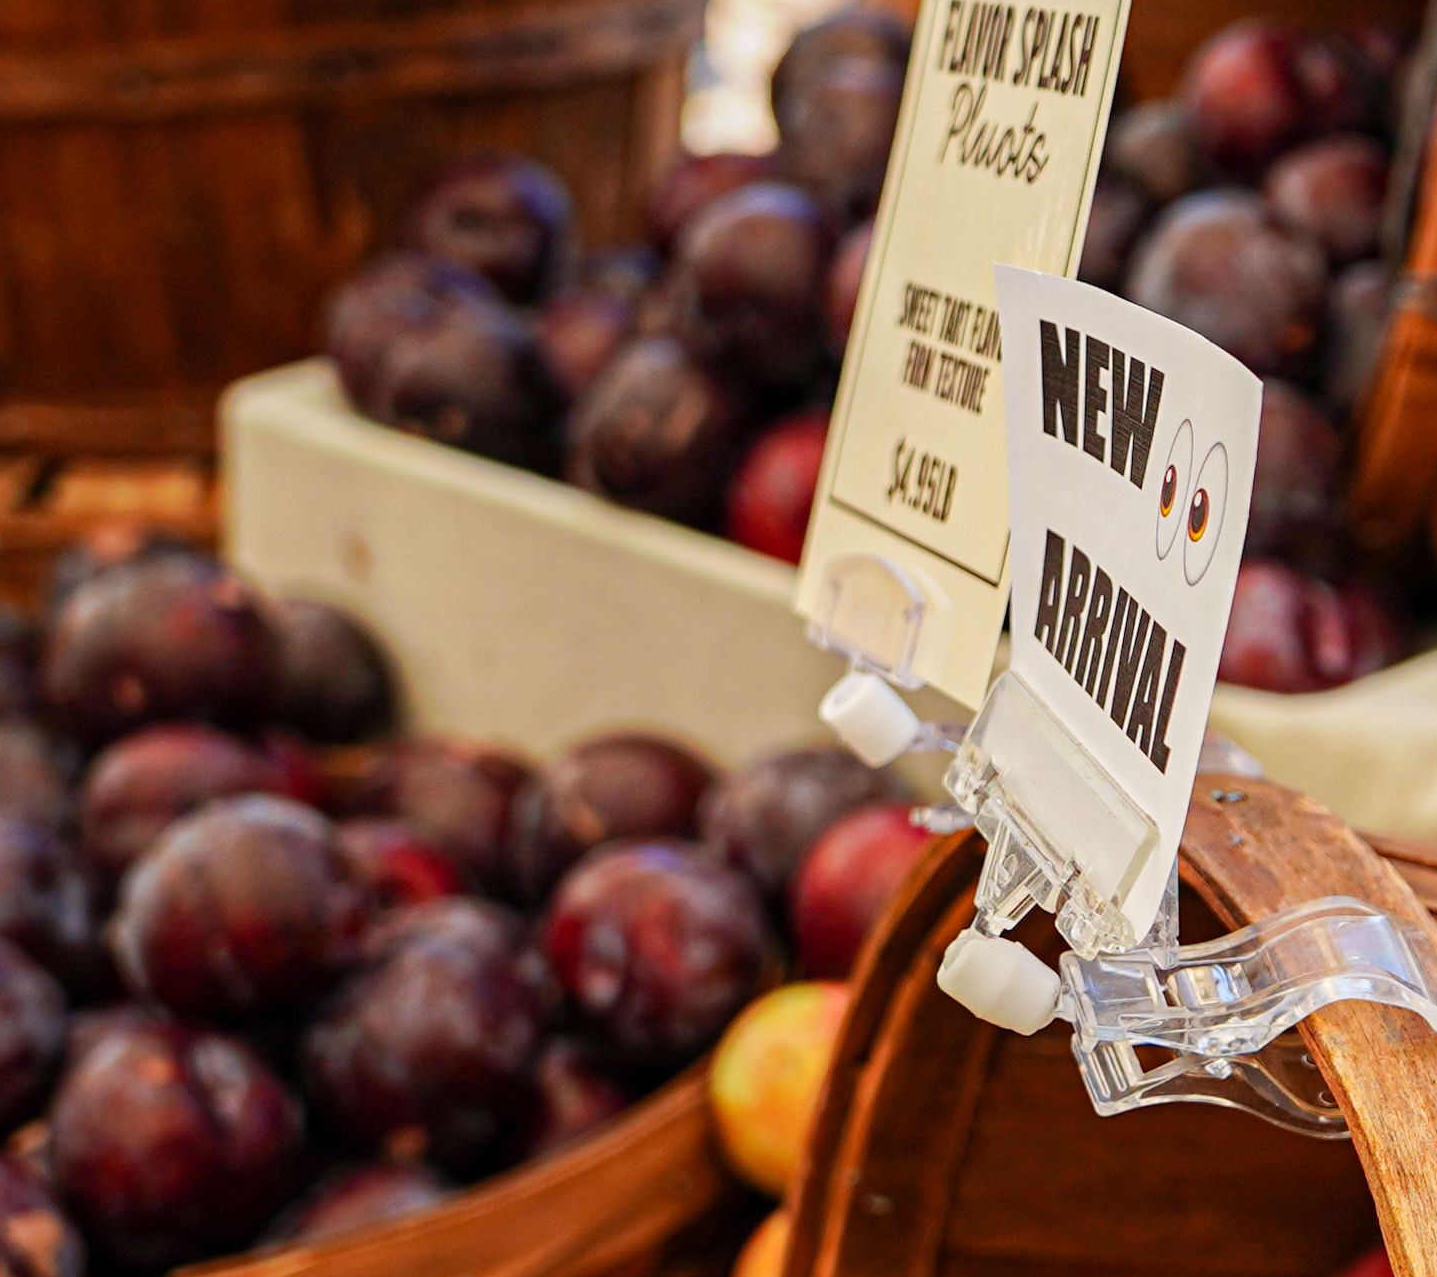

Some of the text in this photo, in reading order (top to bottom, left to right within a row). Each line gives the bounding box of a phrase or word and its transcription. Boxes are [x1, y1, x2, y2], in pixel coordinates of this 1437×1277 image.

[939, 0, 1101, 97] FLAVOR SPLASH
[938, 83, 1050, 184] Pluots
[898, 282, 940, 338] SWEET
[940, 294, 972, 348] TART
[904, 338, 991, 415] FIRM TEXTURE
[1040, 319, 1165, 490] NEW
[887, 436, 958, 522] $4.95LB
[1035, 529, 1187, 774] ARRIVAL
